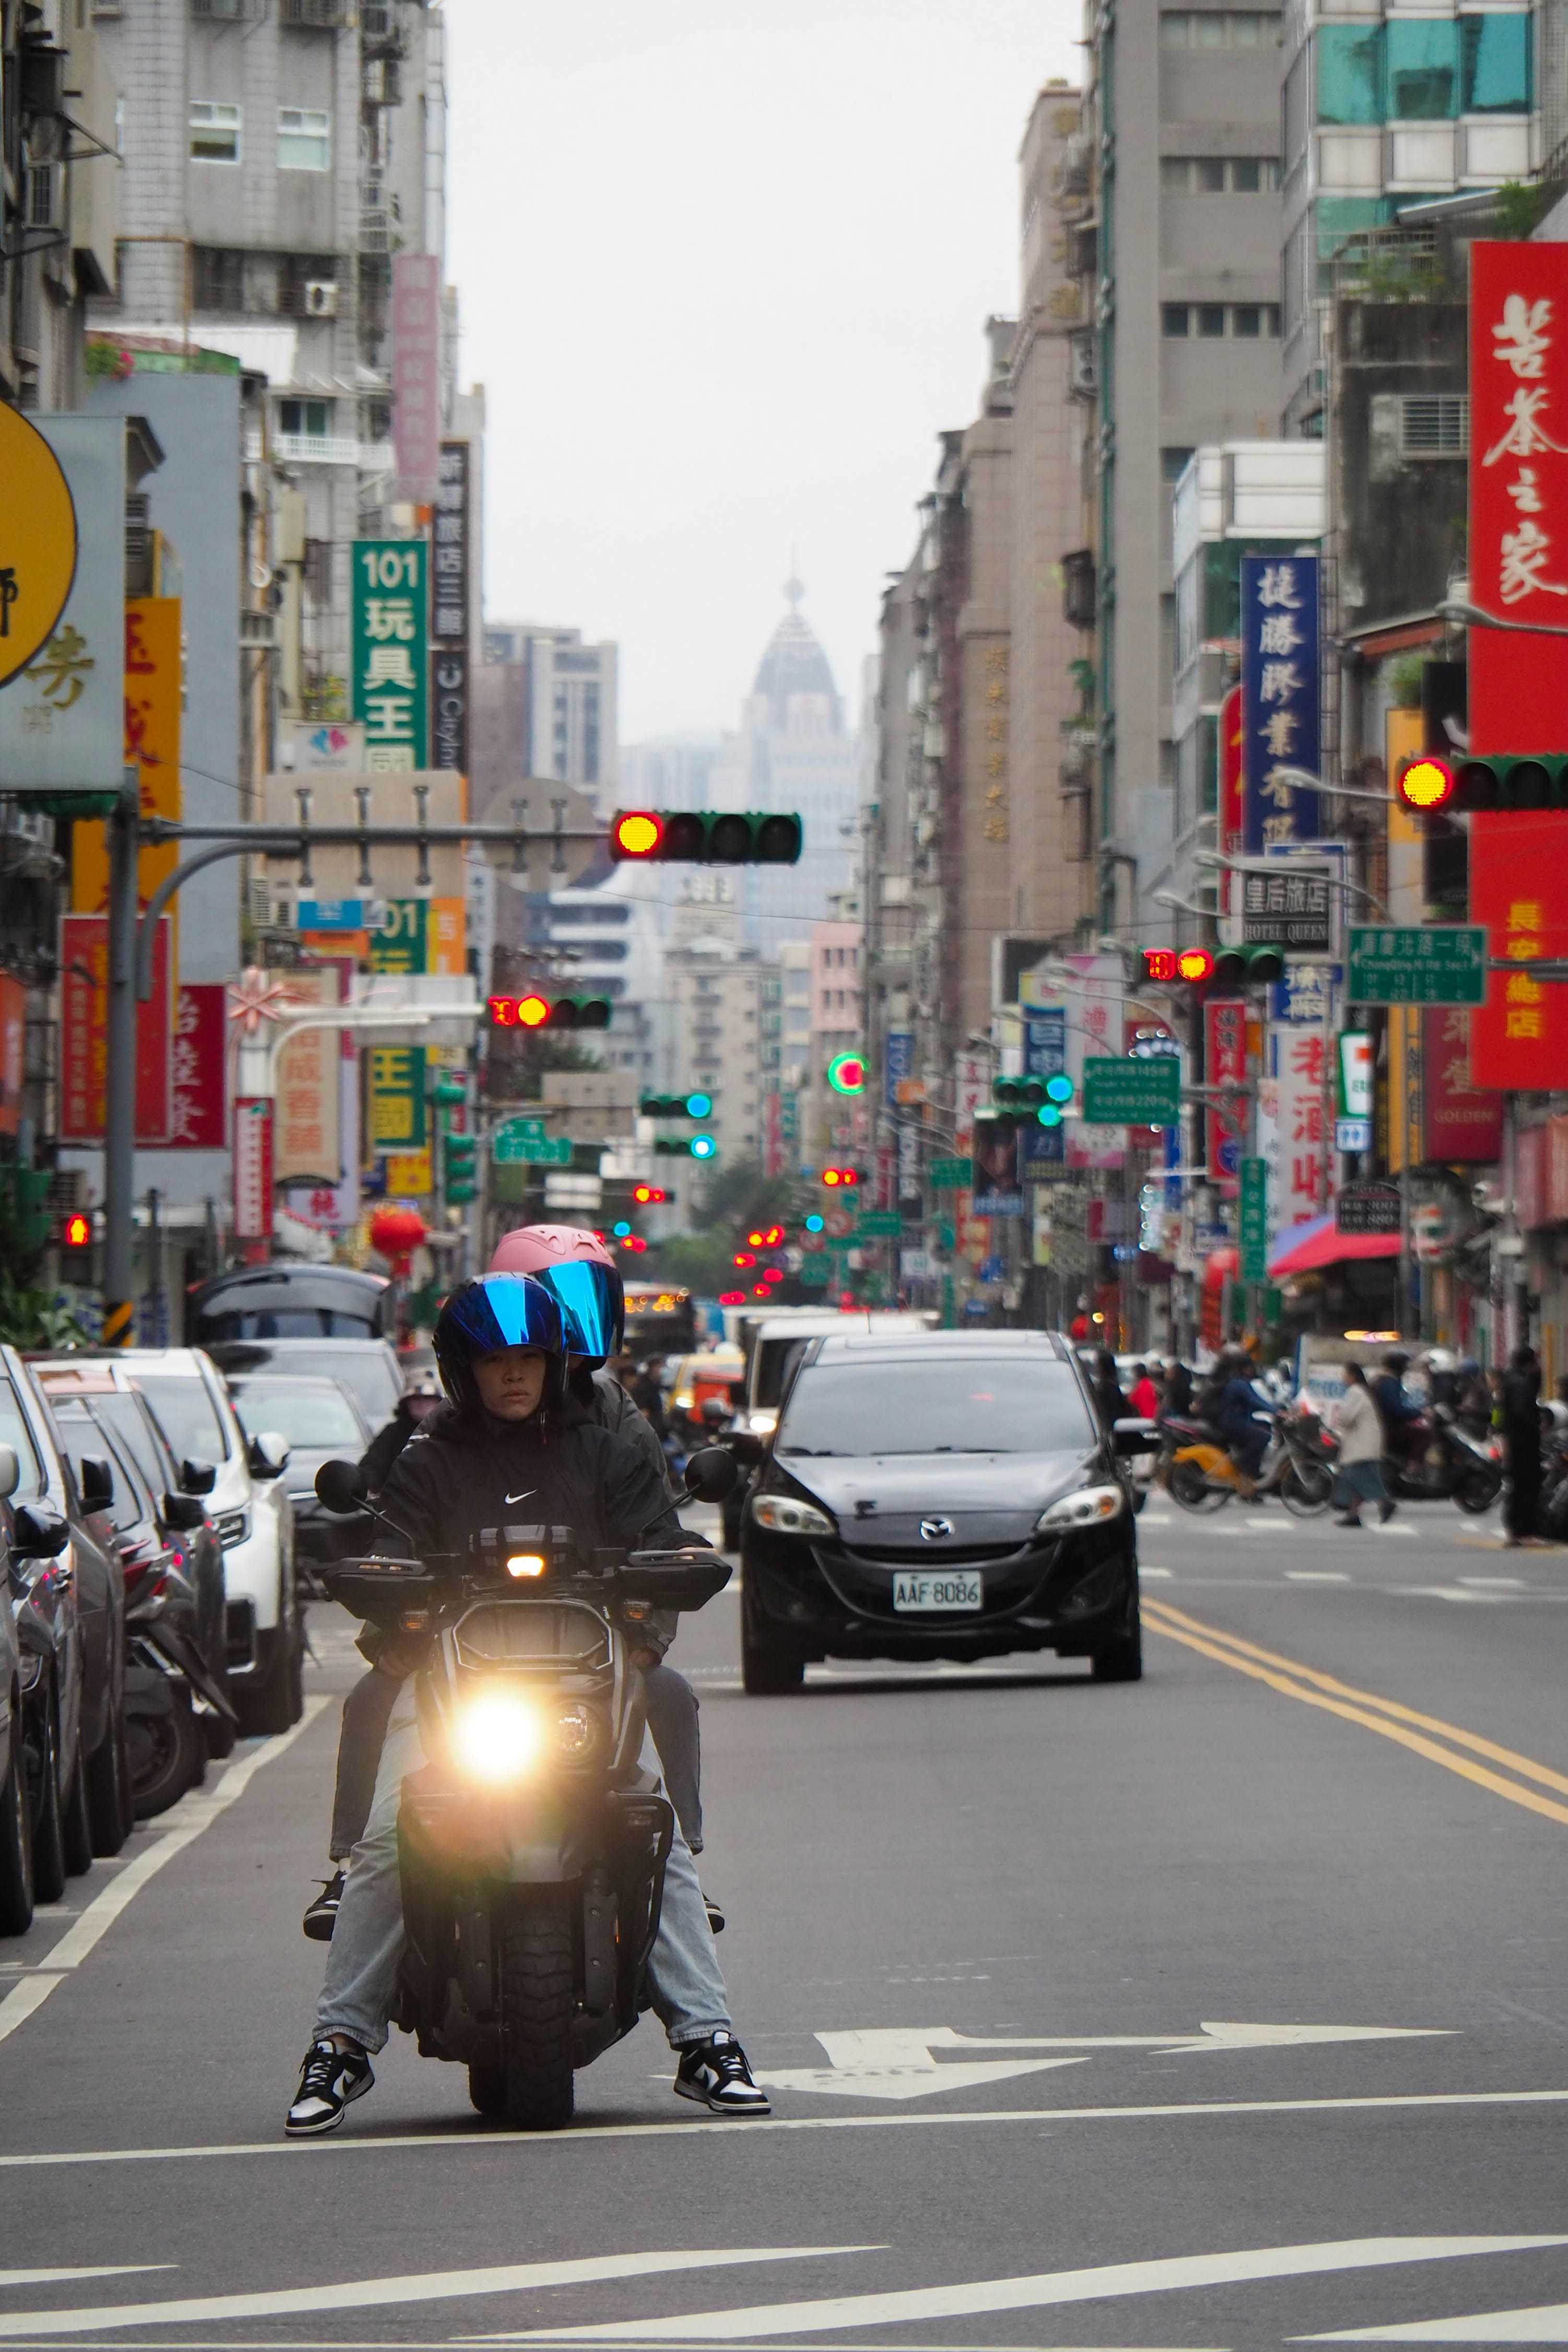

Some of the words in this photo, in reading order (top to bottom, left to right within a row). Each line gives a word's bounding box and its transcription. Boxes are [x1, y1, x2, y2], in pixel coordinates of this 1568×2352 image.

[1245, 877, 1327, 913] 皇后旅店
[1245, 923, 1280, 940] HOTEL
[1287, 923, 1326, 943] QUEEN
[1434, 1110, 1492, 1123] GOLDEN
